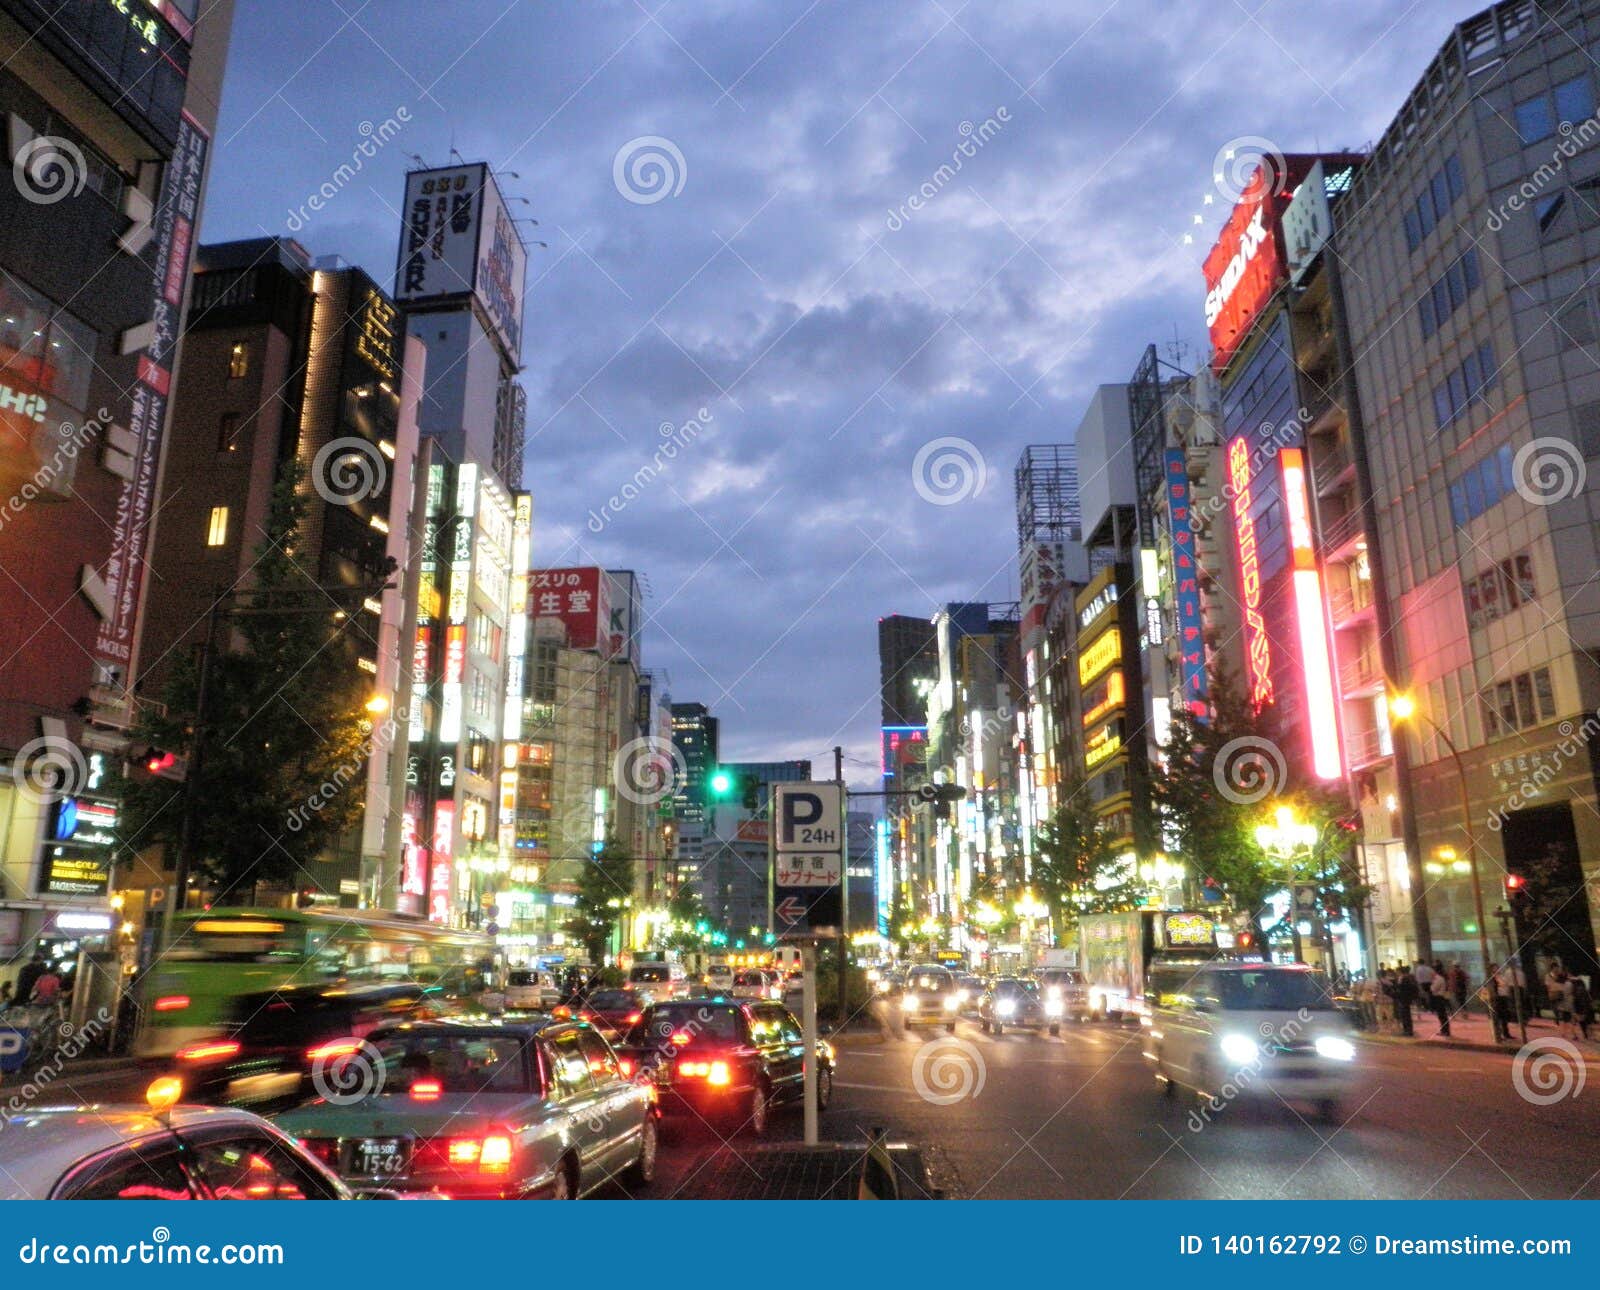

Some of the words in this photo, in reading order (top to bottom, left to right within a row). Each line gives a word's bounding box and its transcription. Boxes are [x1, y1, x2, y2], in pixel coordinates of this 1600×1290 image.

[1204, 205, 1267, 328] SHIDAX
[783, 793, 823, 843] P
[802, 829, 835, 843] 24H
[792, 856, 824, 869] 新宿
[364, 1155, 402, 1172] 15-62
